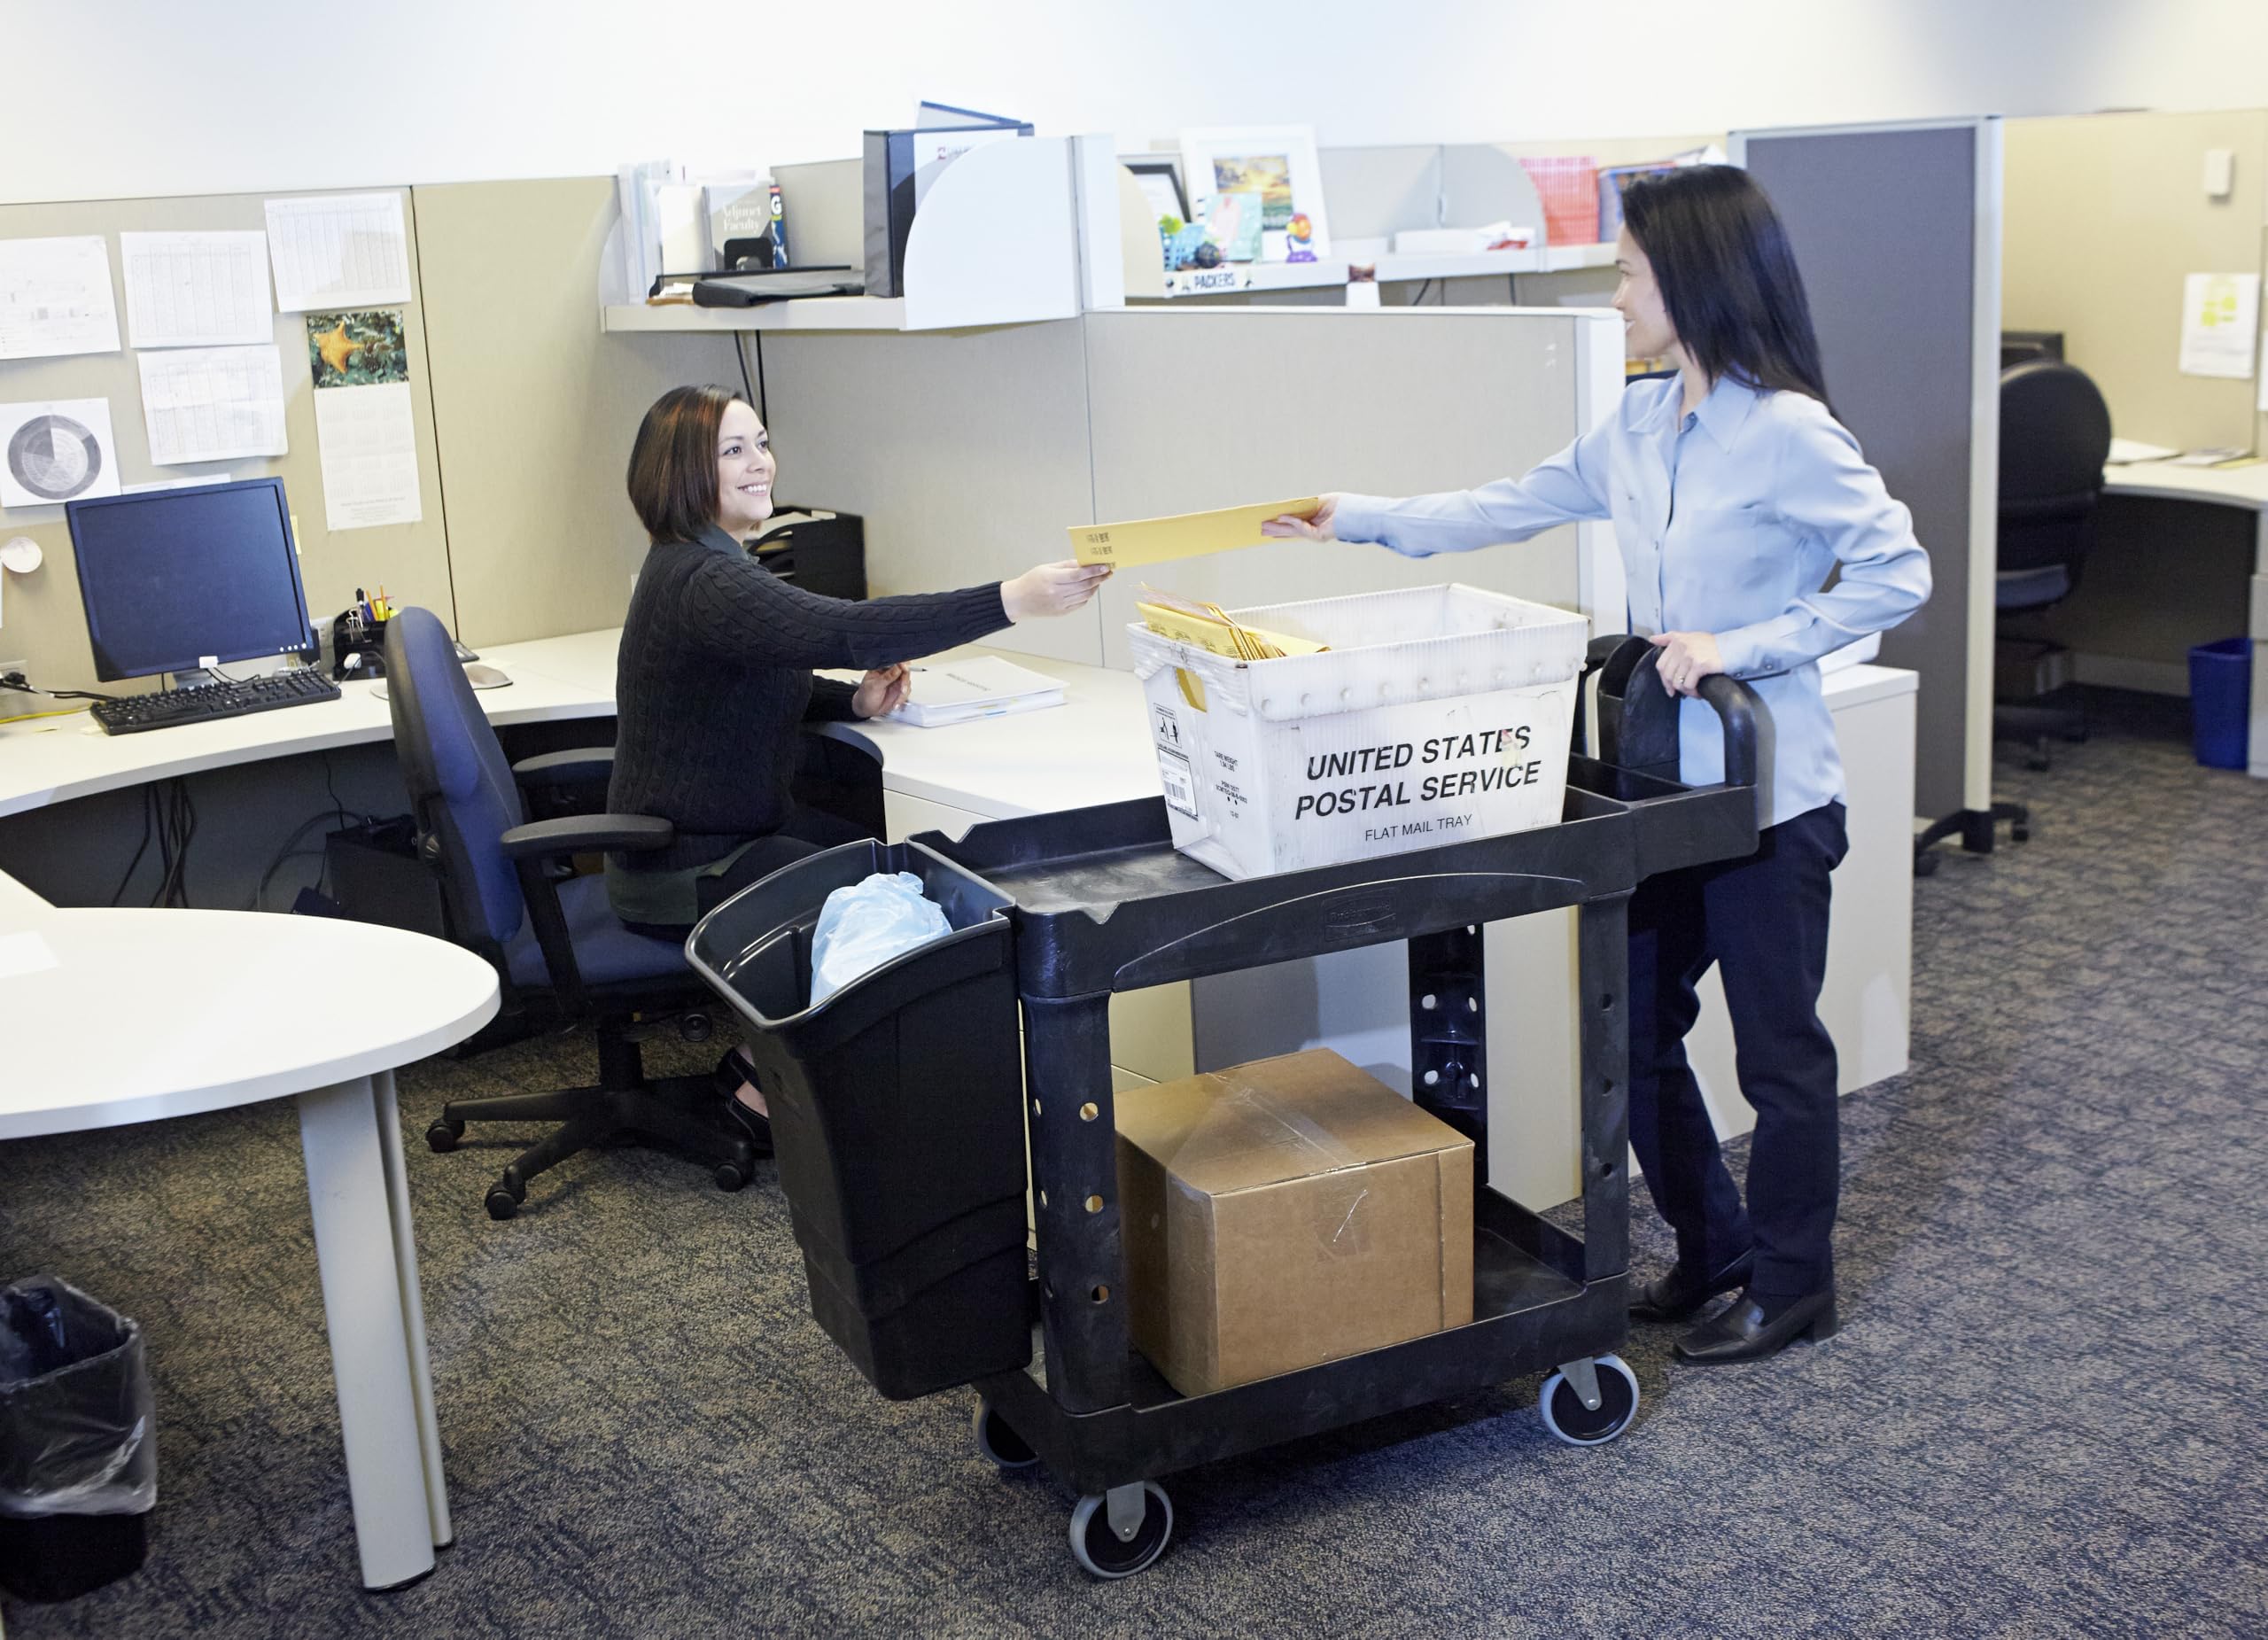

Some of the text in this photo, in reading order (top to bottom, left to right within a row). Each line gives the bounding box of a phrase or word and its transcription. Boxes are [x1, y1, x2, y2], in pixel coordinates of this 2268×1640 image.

[723, 218, 760, 235] Faculty
[1194, 272, 1235, 289] PACKERS
[1307, 726, 1532, 781] UNITED STATES
[1294, 760, 1542, 820] POSTAL SERVICE
[1364, 814, 1473, 842] FLAT MAIL TRAY
